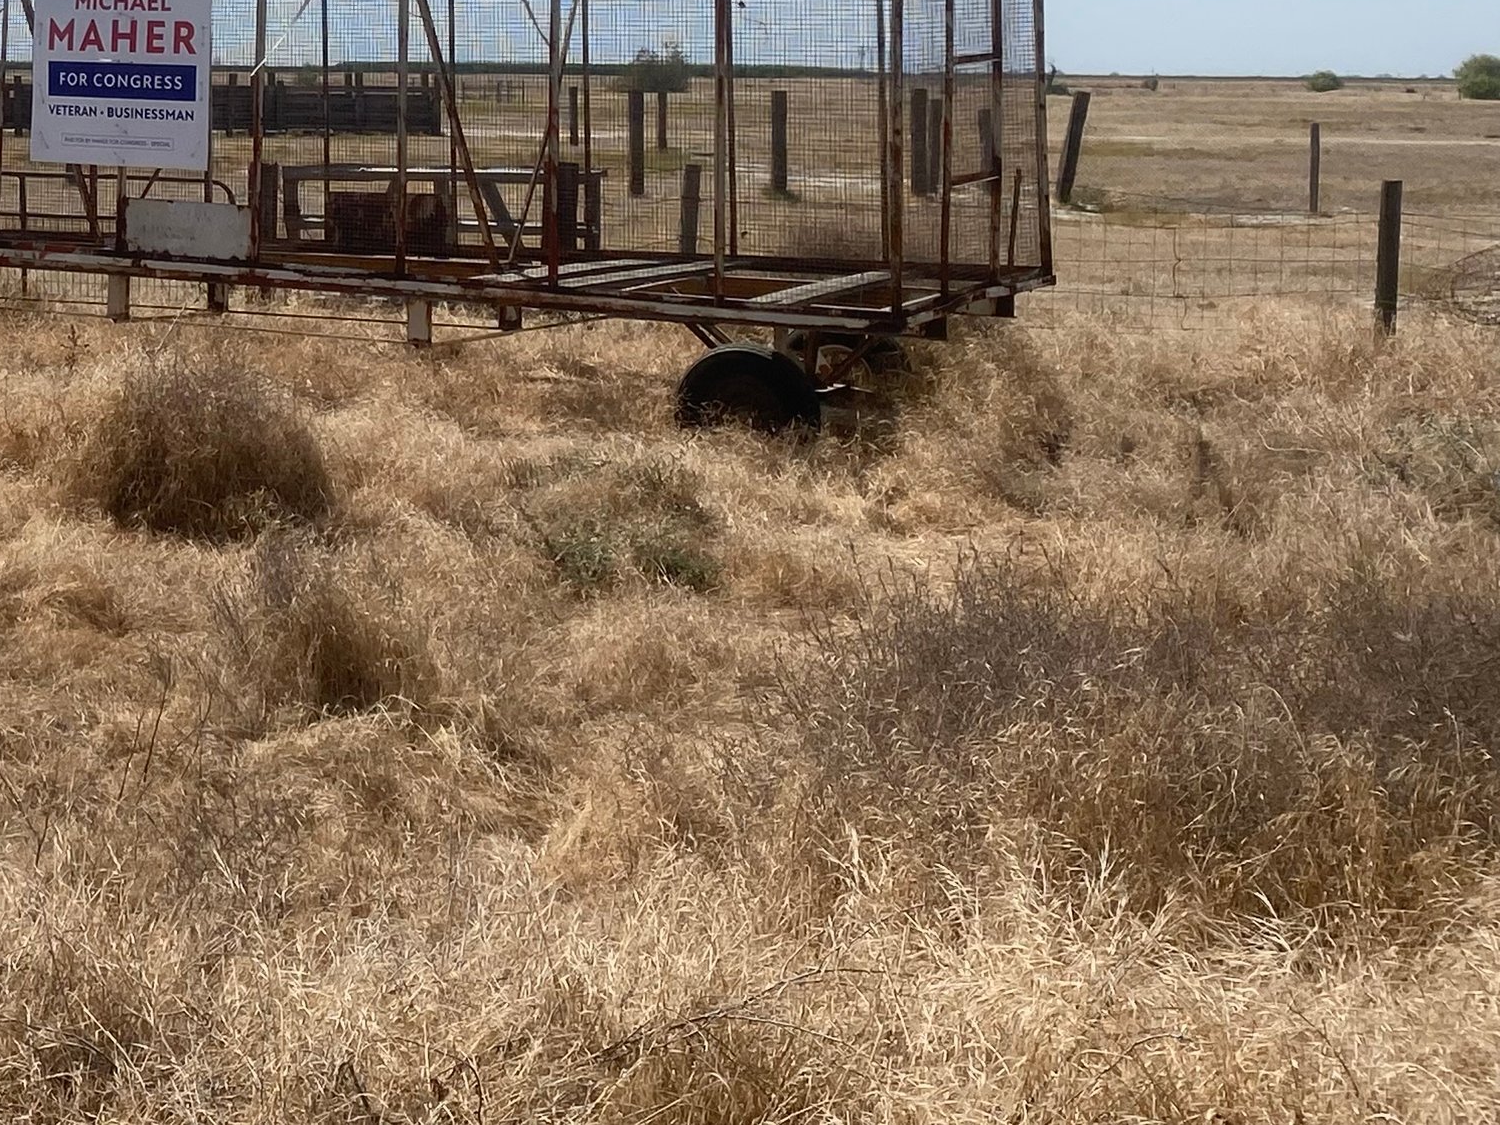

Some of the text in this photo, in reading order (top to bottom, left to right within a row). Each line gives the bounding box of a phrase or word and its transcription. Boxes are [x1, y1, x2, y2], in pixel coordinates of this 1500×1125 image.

[48, 18, 197, 55] MAHER
[59, 72, 183, 90] FOR CONGRESS
[48, 104, 194, 121] VETERAN BUSINESSMAN
